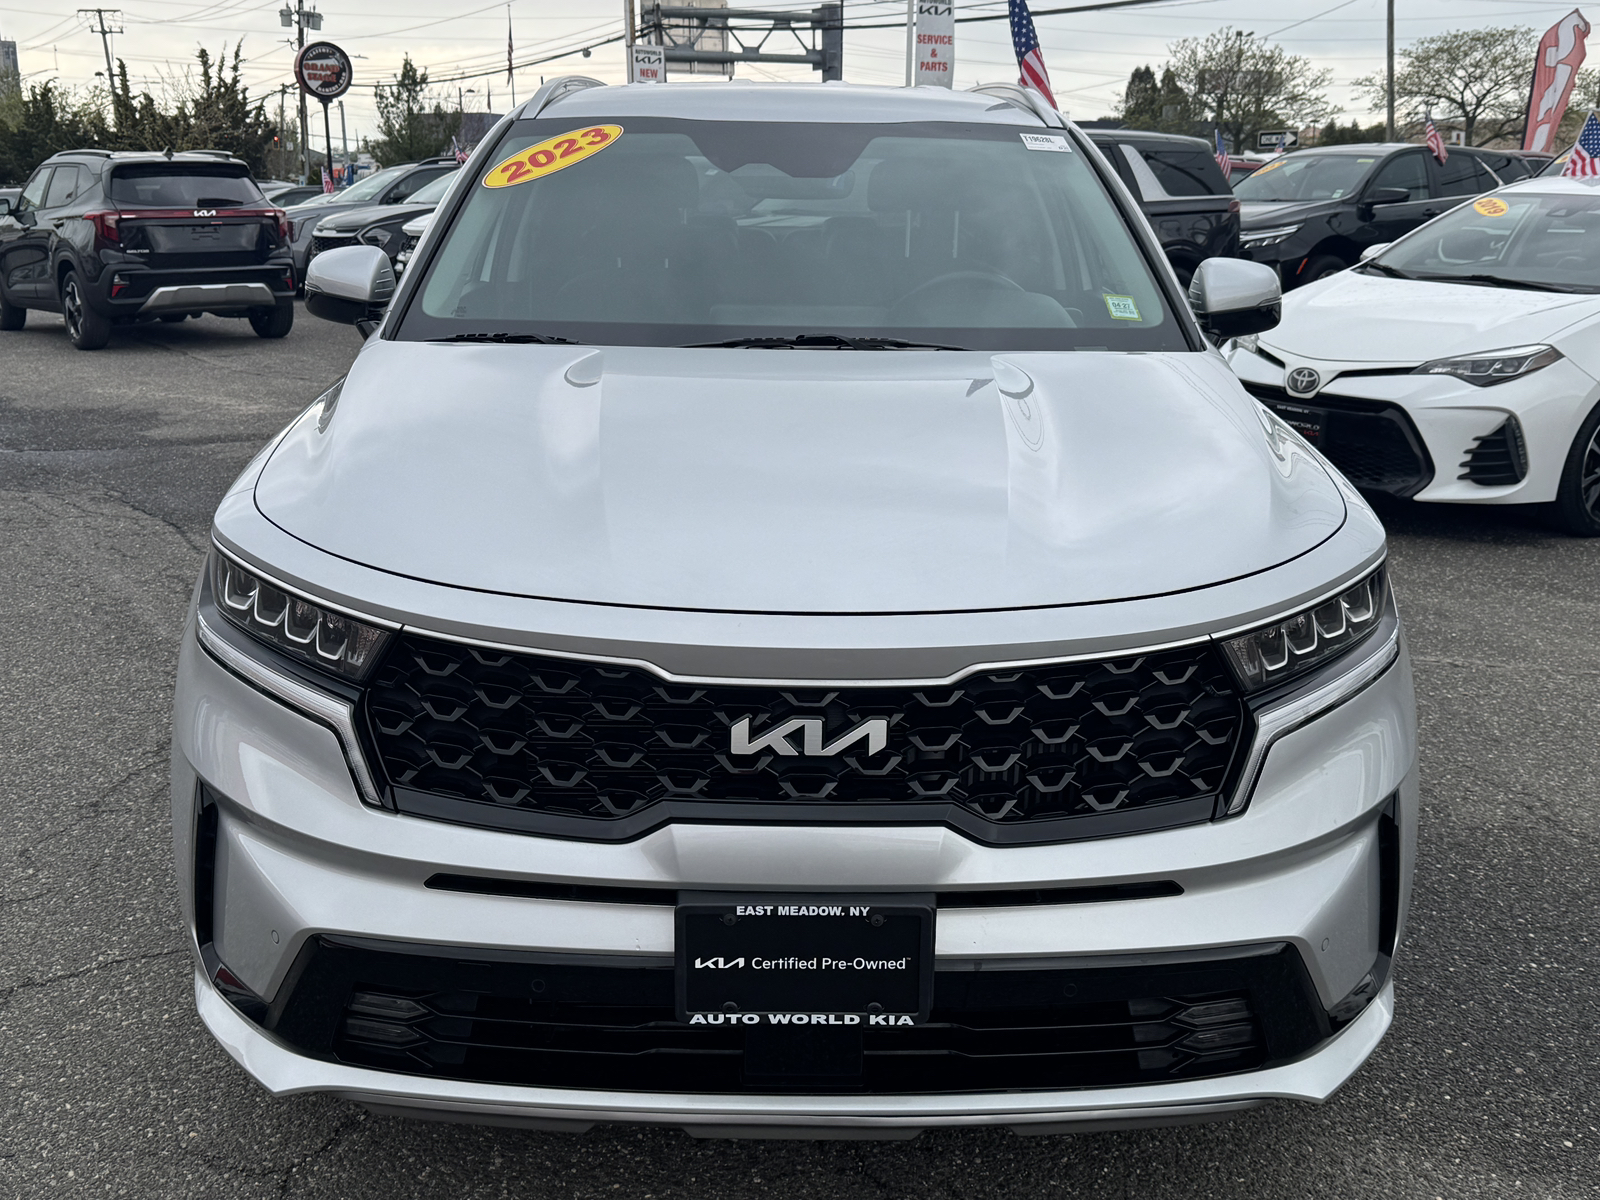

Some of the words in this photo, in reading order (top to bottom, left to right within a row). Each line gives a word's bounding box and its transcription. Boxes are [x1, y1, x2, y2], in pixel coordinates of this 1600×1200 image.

[919, 5, 952, 16] KIA
[917, 34, 953, 45] SERVICE
[930, 48, 938, 58] &
[635, 55, 662, 64] KIA
[303, 63, 340, 72] GRAND
[920, 61, 948, 72] PARTS
[307, 72, 336, 82] STAGE
[640, 68, 658, 78] NEW
[500, 127, 612, 184] 2023
[1476, 199, 1505, 214] 2019
[193, 209, 217, 217] KIA
[730, 713, 889, 757] KIA
[736, 905, 774, 917] EAST
[777, 905, 846, 917] MEADOW,
[849, 906, 871, 917] NY
[694, 956, 746, 970] KIA
[751, 956, 818, 971] Certified
[688, 1013, 761, 1026] AUTO
[767, 1013, 861, 1026] WORLD
[869, 1014, 915, 1027] KIA
